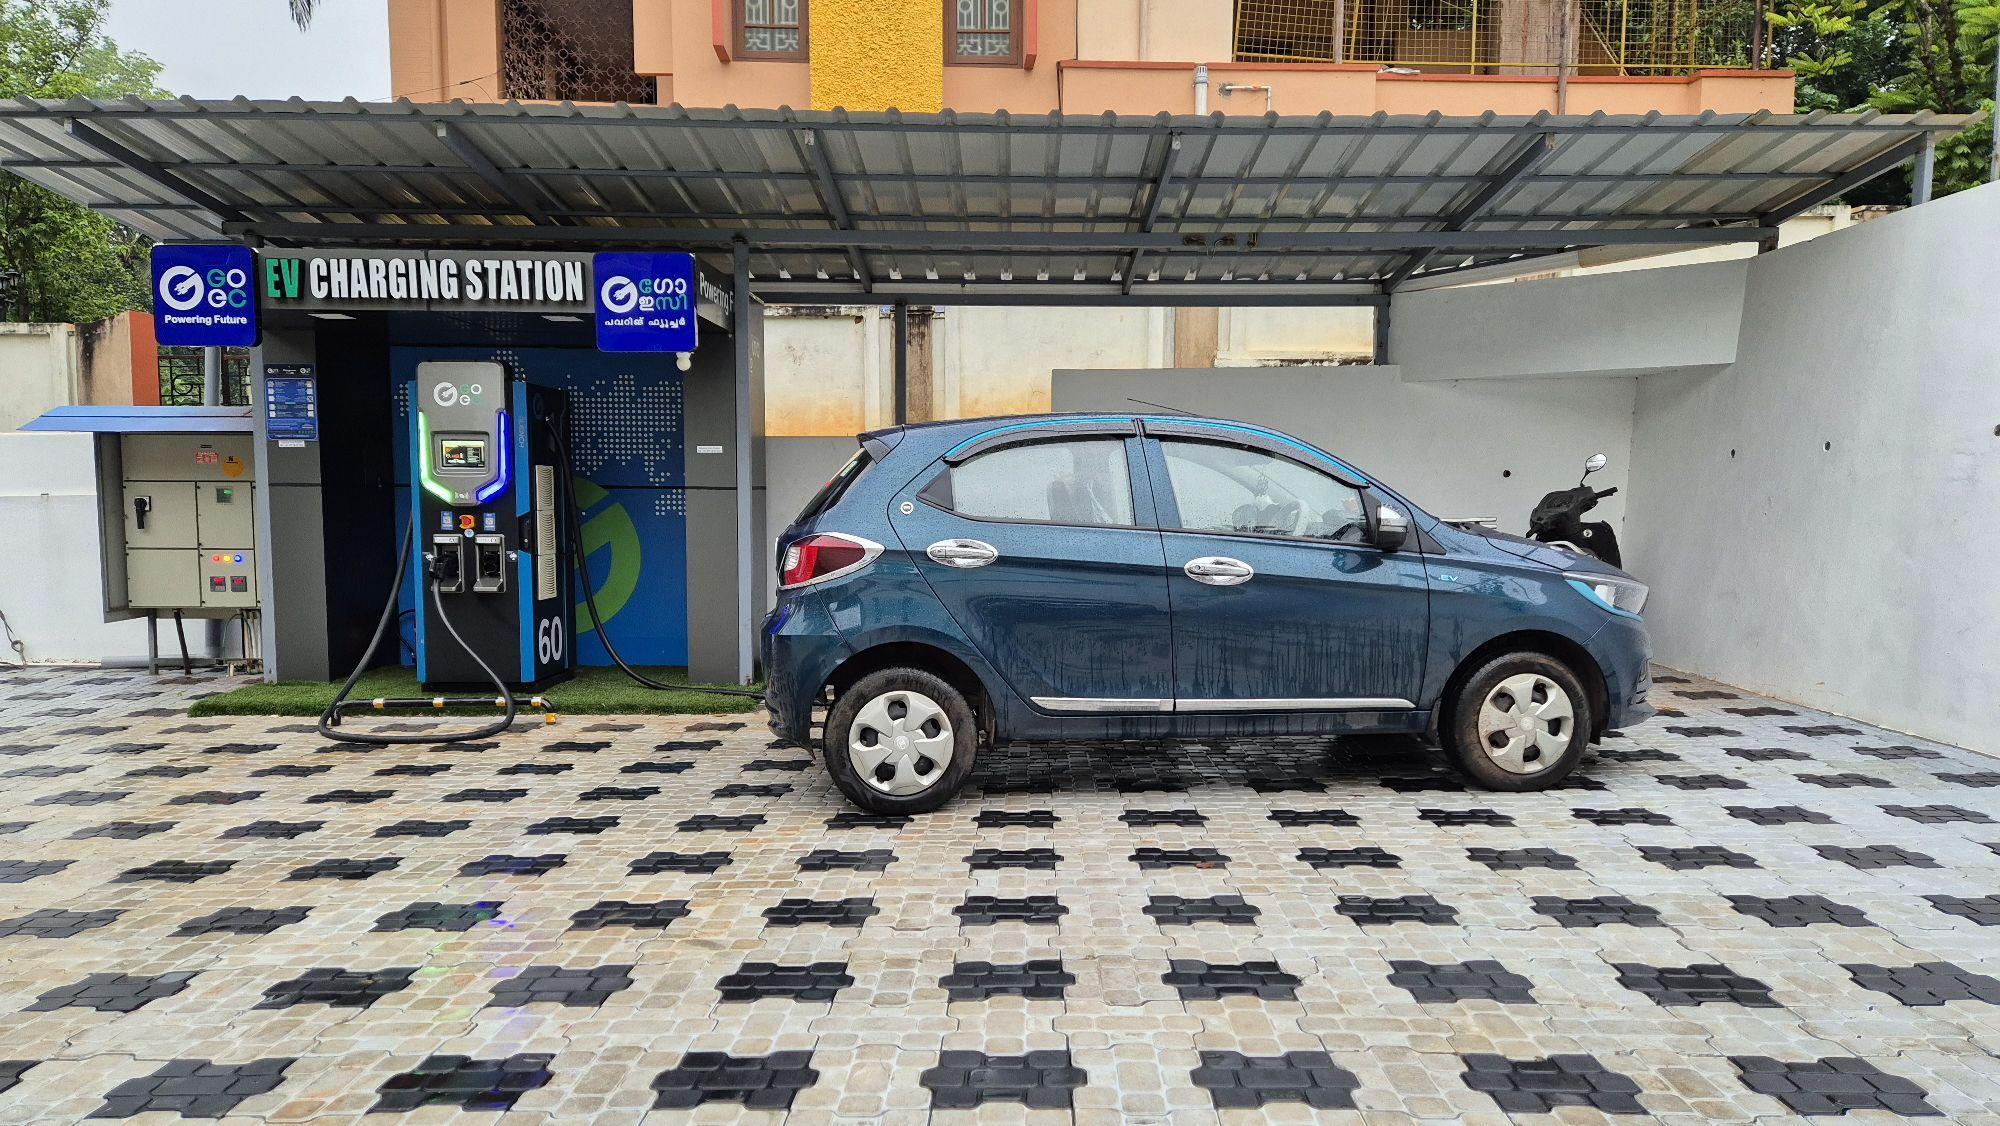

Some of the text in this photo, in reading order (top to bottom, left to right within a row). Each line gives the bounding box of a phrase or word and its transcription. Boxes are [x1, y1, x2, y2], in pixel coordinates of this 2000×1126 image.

[207, 268, 247, 288] GO
[265, 257, 584, 302] EV CHARGING STATION
[699, 271, 729, 316] Powering
[164, 314, 248, 326] Powering Future
[538, 615, 563, 665] 60
